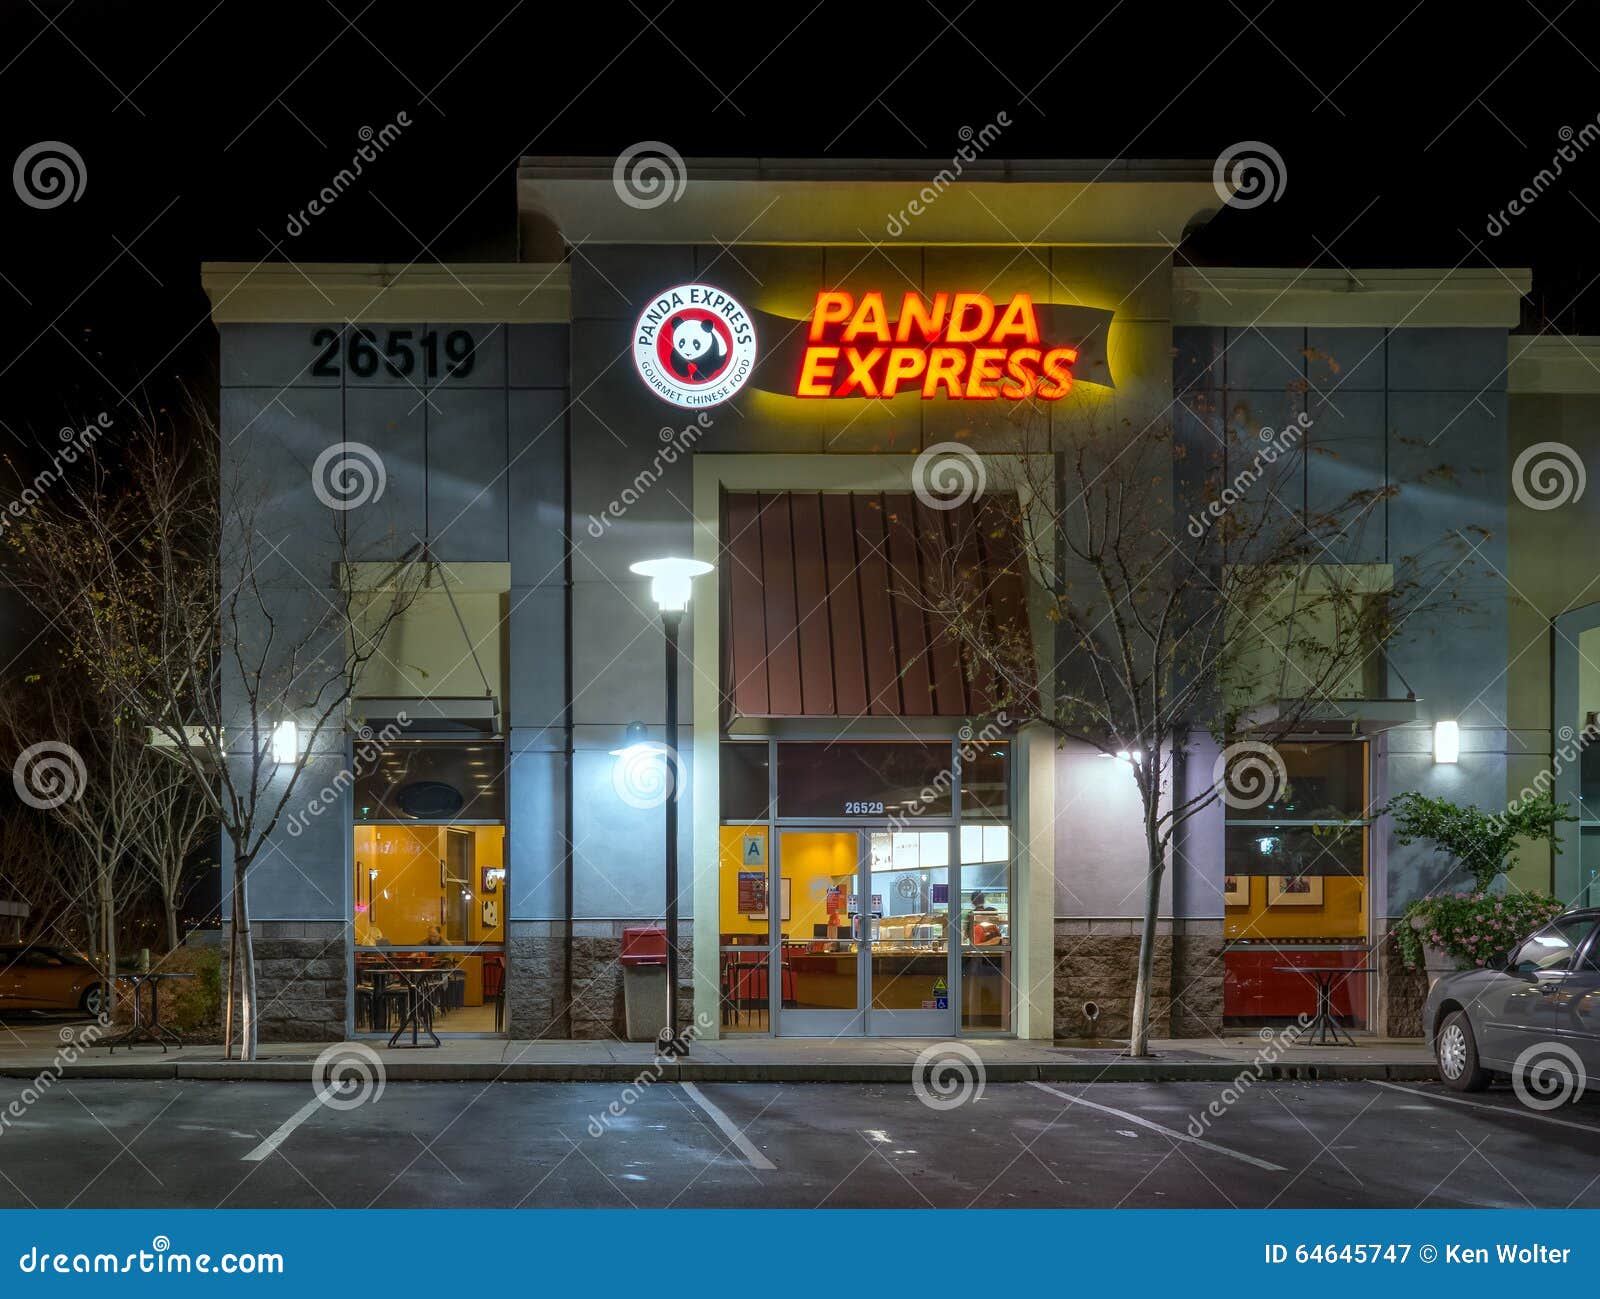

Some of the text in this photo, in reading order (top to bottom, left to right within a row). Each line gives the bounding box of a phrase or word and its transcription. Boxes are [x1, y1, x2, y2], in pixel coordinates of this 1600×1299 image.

[638, 288, 752, 346] PANDA EXPRESS
[808, 291, 1041, 343] PANDA
[311, 328, 476, 379] 26519
[796, 345, 1078, 400] EXPRESS
[641, 359, 750, 404] GOURMET CHINESE FOOD
[845, 801, 884, 814] 26529
[748, 841, 760, 856] A
